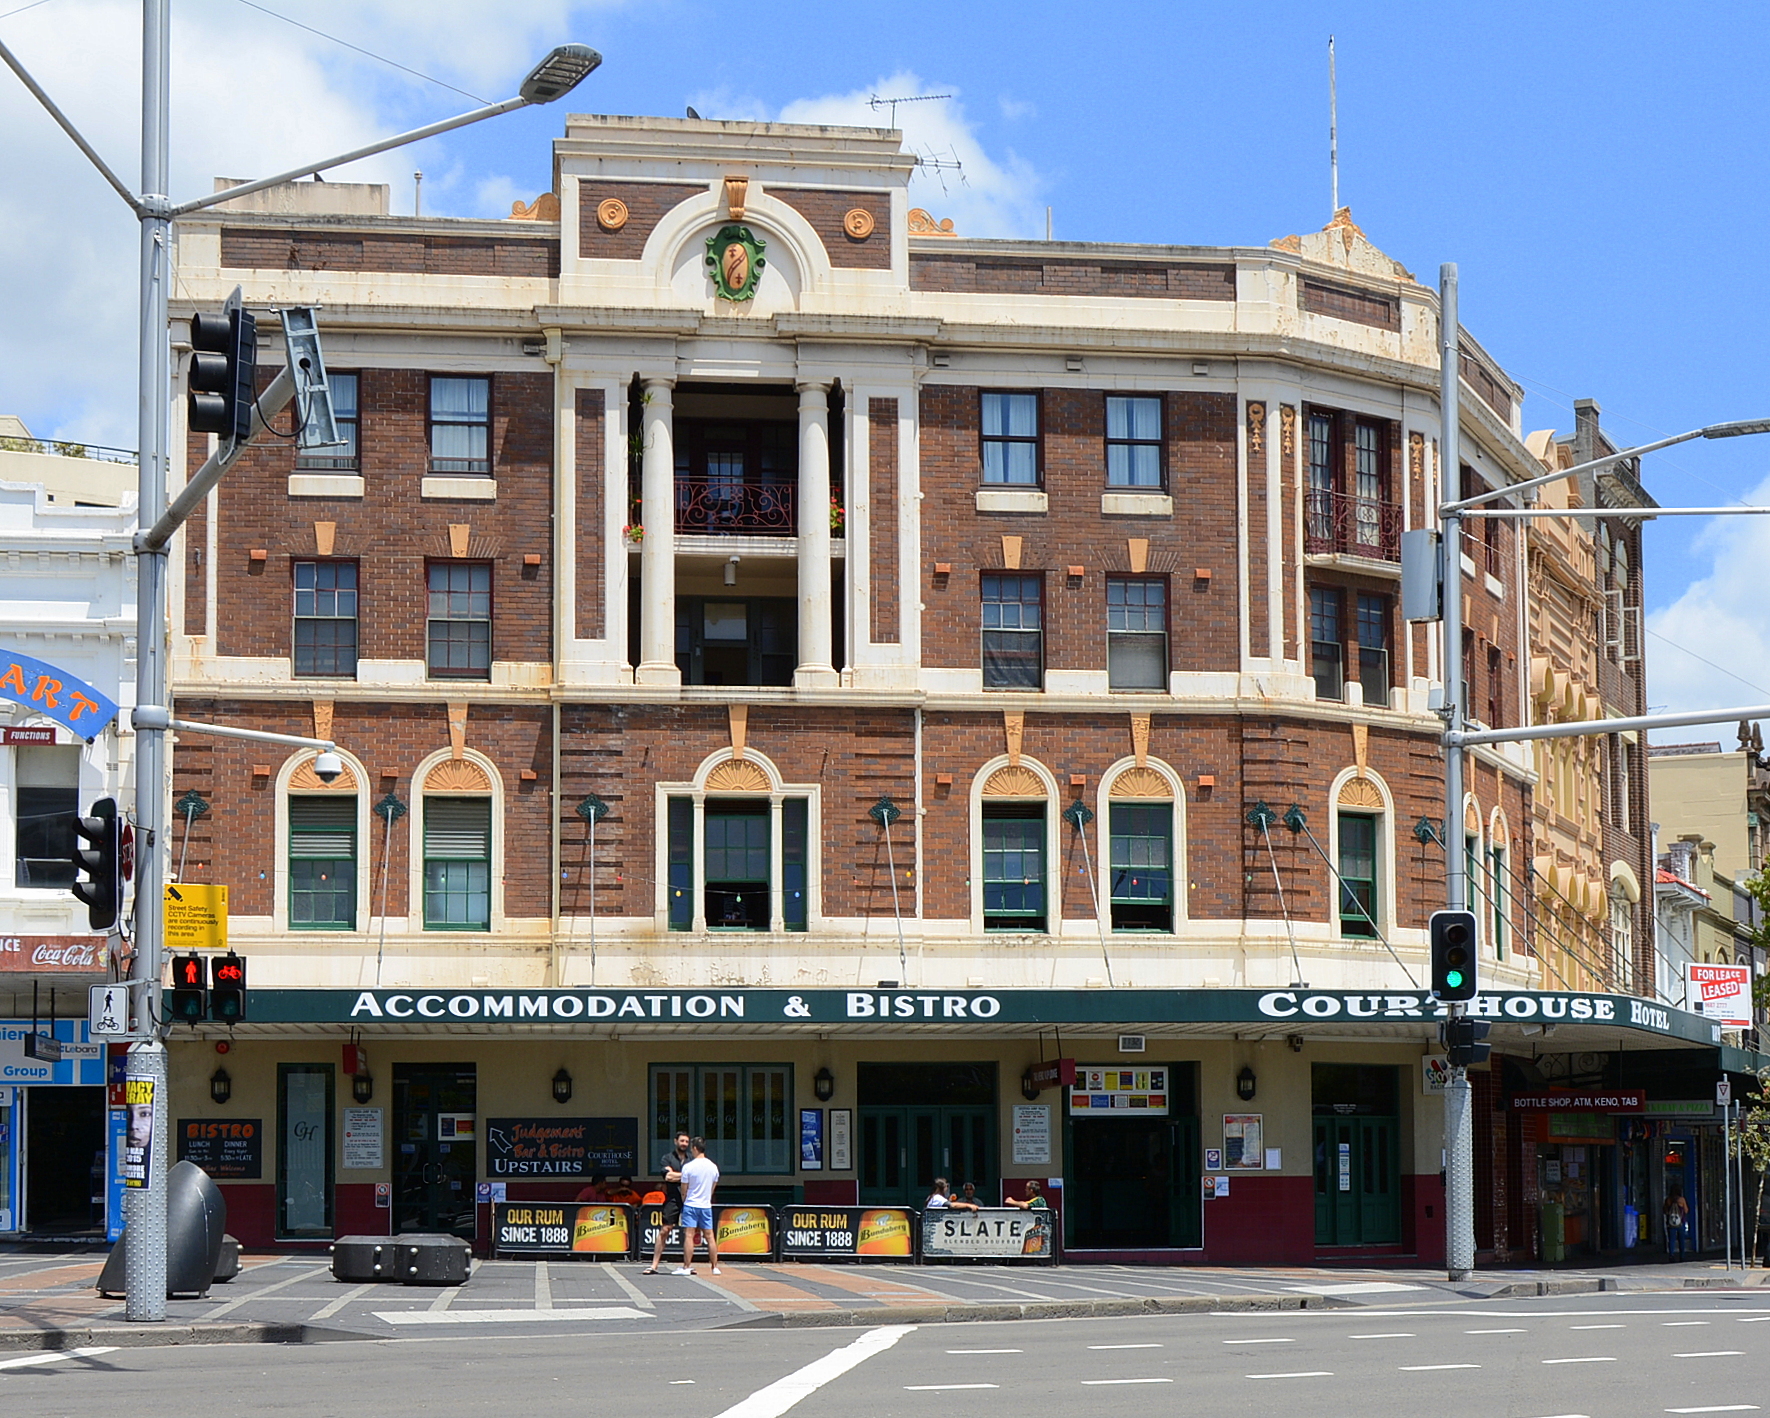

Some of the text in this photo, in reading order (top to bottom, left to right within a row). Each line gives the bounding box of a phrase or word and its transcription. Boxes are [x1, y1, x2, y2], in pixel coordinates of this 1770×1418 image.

[10, 730, 51, 741] FUNCTIONS
[1697, 968, 1715, 981] FOR
[1703, 981, 1739, 998] LEASED
[350, 992, 1001, 1018] ACCOMMODATION & BISTRO
[1631, 1000, 1670, 1030] HOTEL
[65, 1044, 98, 1053] Lebara
[3, 1065, 48, 1078] Group
[1514, 1097, 1638, 1109] BOTTLE SHOP, ATM, KENO, TAB
[1686, 1103, 1709, 1112] PIZZA
[187, 1123, 255, 1138] BISTRO
[511, 1123, 586, 1143] Judgement
[513, 1143, 585, 1158] Bar & Bistro
[587, 1151, 632, 1159] COURTHOUSE
[494, 1158, 583, 1173] UPSTAIRS
[507, 1209, 563, 1225] OUR RUM
[792, 1213, 847, 1229] OUR RUM
[501, 1227, 568, 1243] SINCE 1888
[719, 1221, 766, 1239] Bundaberg
[860, 1223, 907, 1241] Bundaberg
[944, 1220, 1021, 1237] SLATE
[786, 1230, 852, 1247] SINCE 1888
